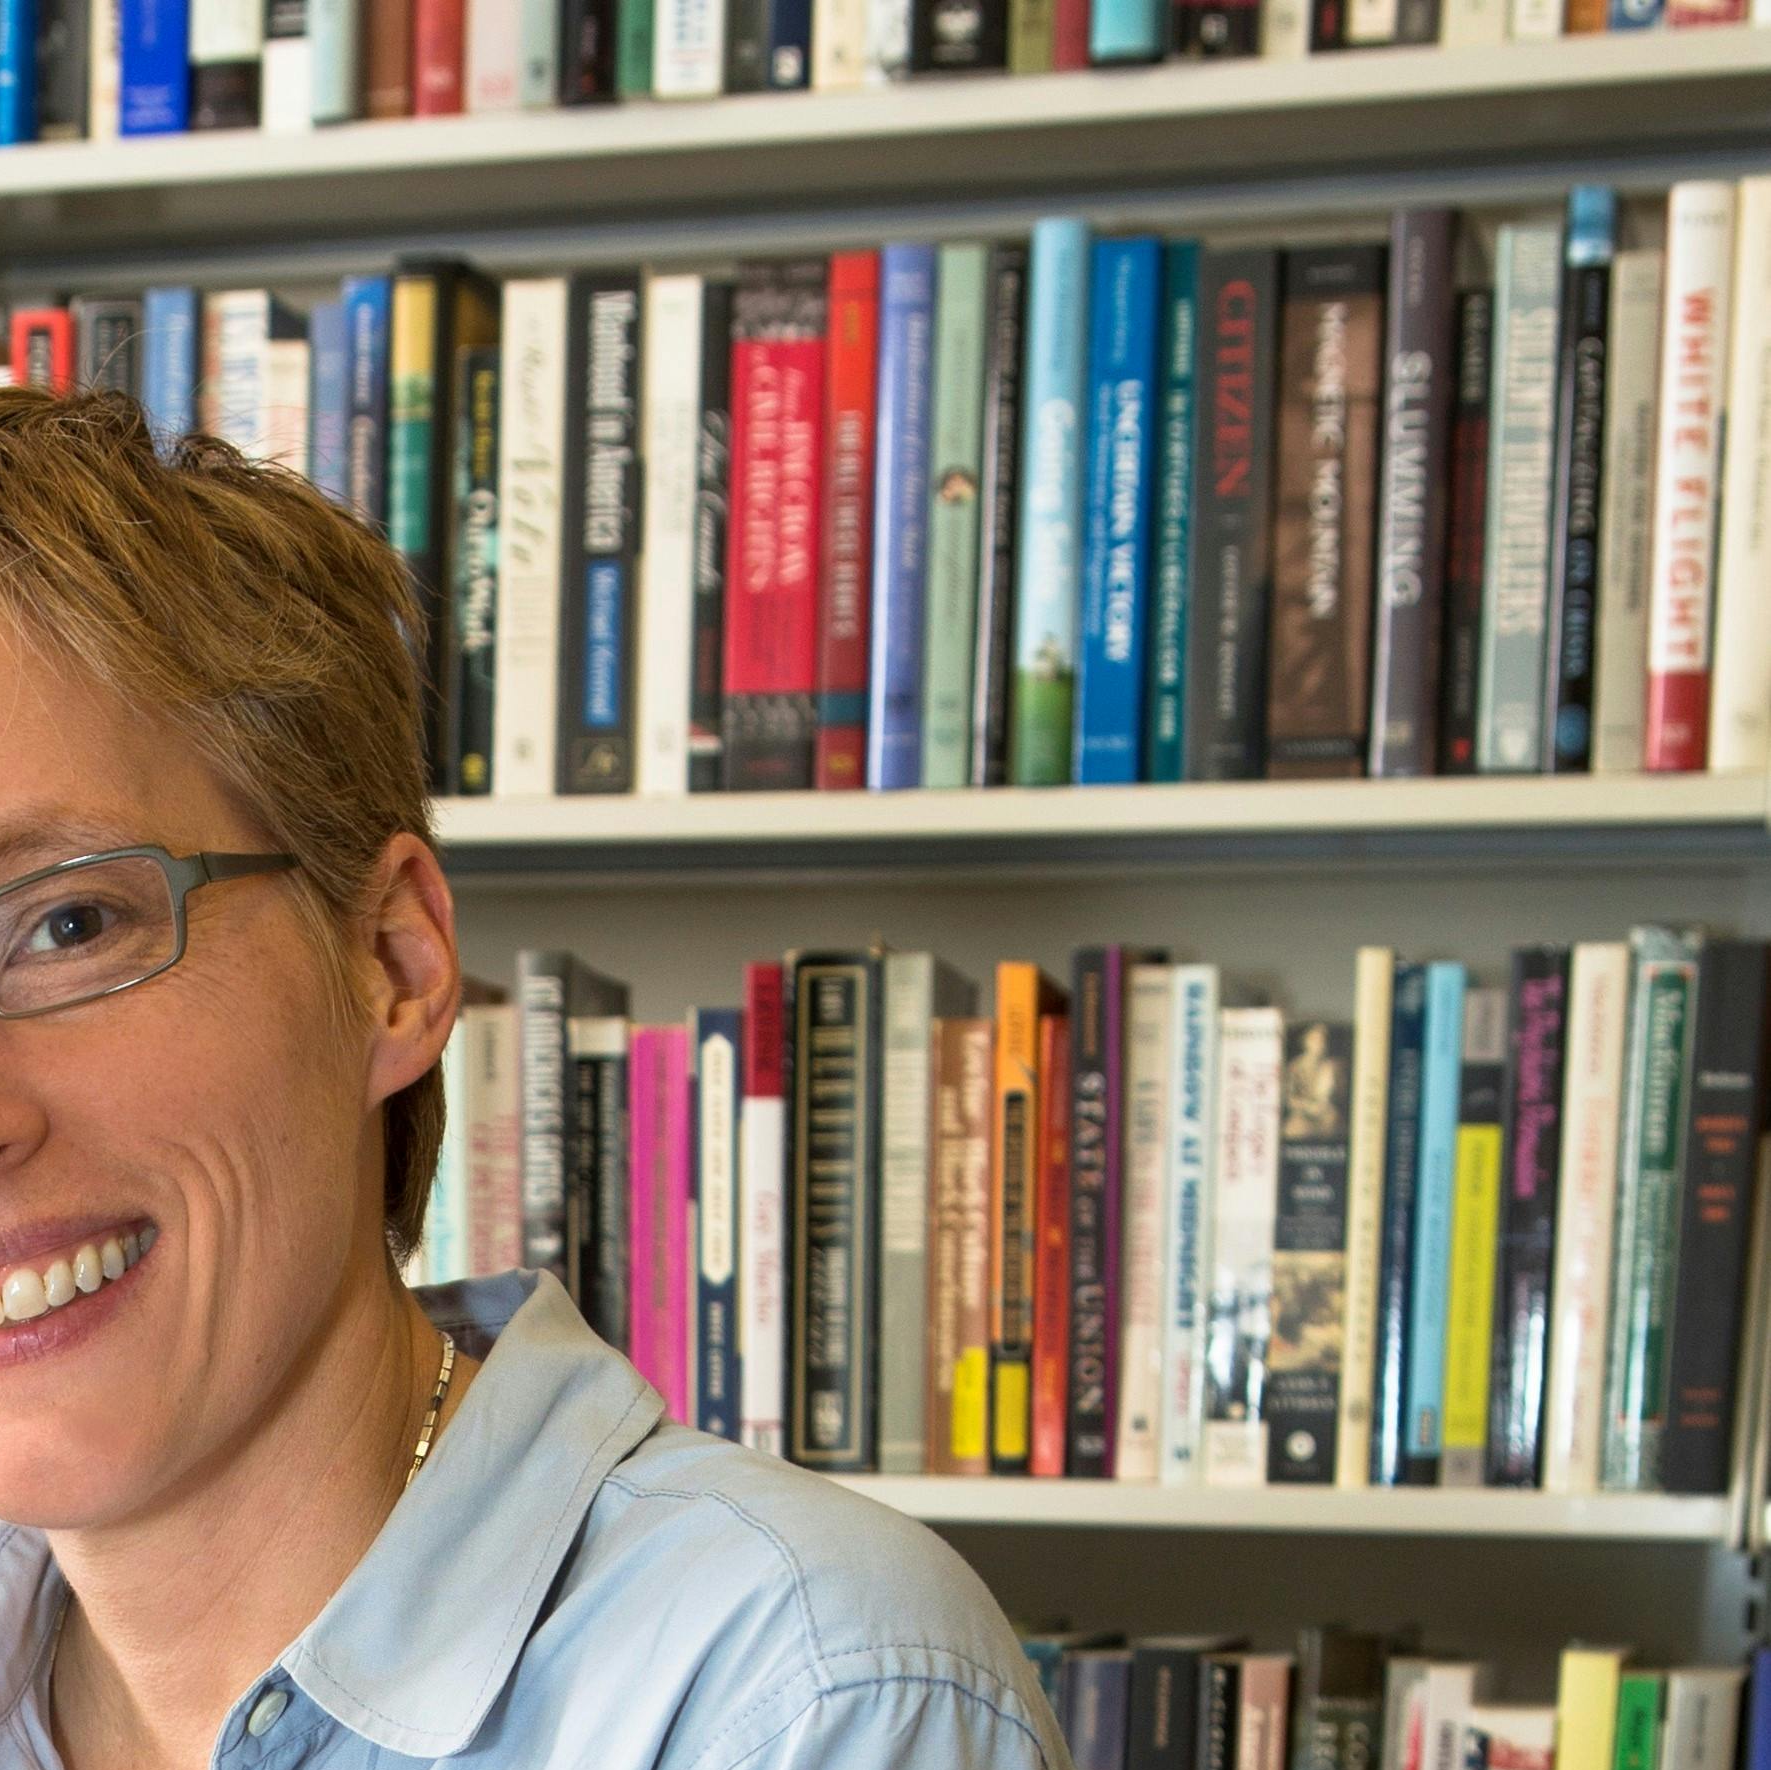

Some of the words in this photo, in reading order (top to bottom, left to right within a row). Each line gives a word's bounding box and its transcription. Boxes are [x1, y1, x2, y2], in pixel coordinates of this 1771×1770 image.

[587, 289, 635, 410] Manhood
[746, 365, 779, 455] CIVIL
[1213, 279, 1258, 498] CITIZEN
[1309, 301, 1349, 449] MAGNETIC
[1506, 306, 1557, 432] SILENT
[1673, 287, 1718, 458] WHITE
[587, 415, 628, 440] in
[781, 419, 811, 477] JIM
[1029, 398, 1076, 515] Going
[1111, 379, 1142, 538] UNCERTAIN
[1382, 349, 1432, 609] SLUMMING
[583, 445, 632, 553] America
[744, 460, 778, 594] RIGHTS
[778, 480, 809, 586] CROW
[1306, 458, 1344, 619] MOUNTAIN
[1495, 437, 1553, 637] TRAVELERS
[592, 567, 617, 639] Michael
[1036, 521, 1070, 603] Solo
[1104, 542, 1138, 663] VICTORY
[1664, 475, 1709, 661] FLIGHT
[526, 975, 562, 1009] AT
[1183, 982, 1205, 1123] RAINBOW
[938, 1138, 960, 1208] Black
[960, 1136, 986, 1209] Black
[1075, 1071, 1107, 1191] STATE
[749, 1190, 775, 1234] Gay
[1176, 1178, 1197, 1330] MIDNIGHT
[755, 1249, 780, 1326] Macho
[1072, 1283, 1105, 1414] UNION
